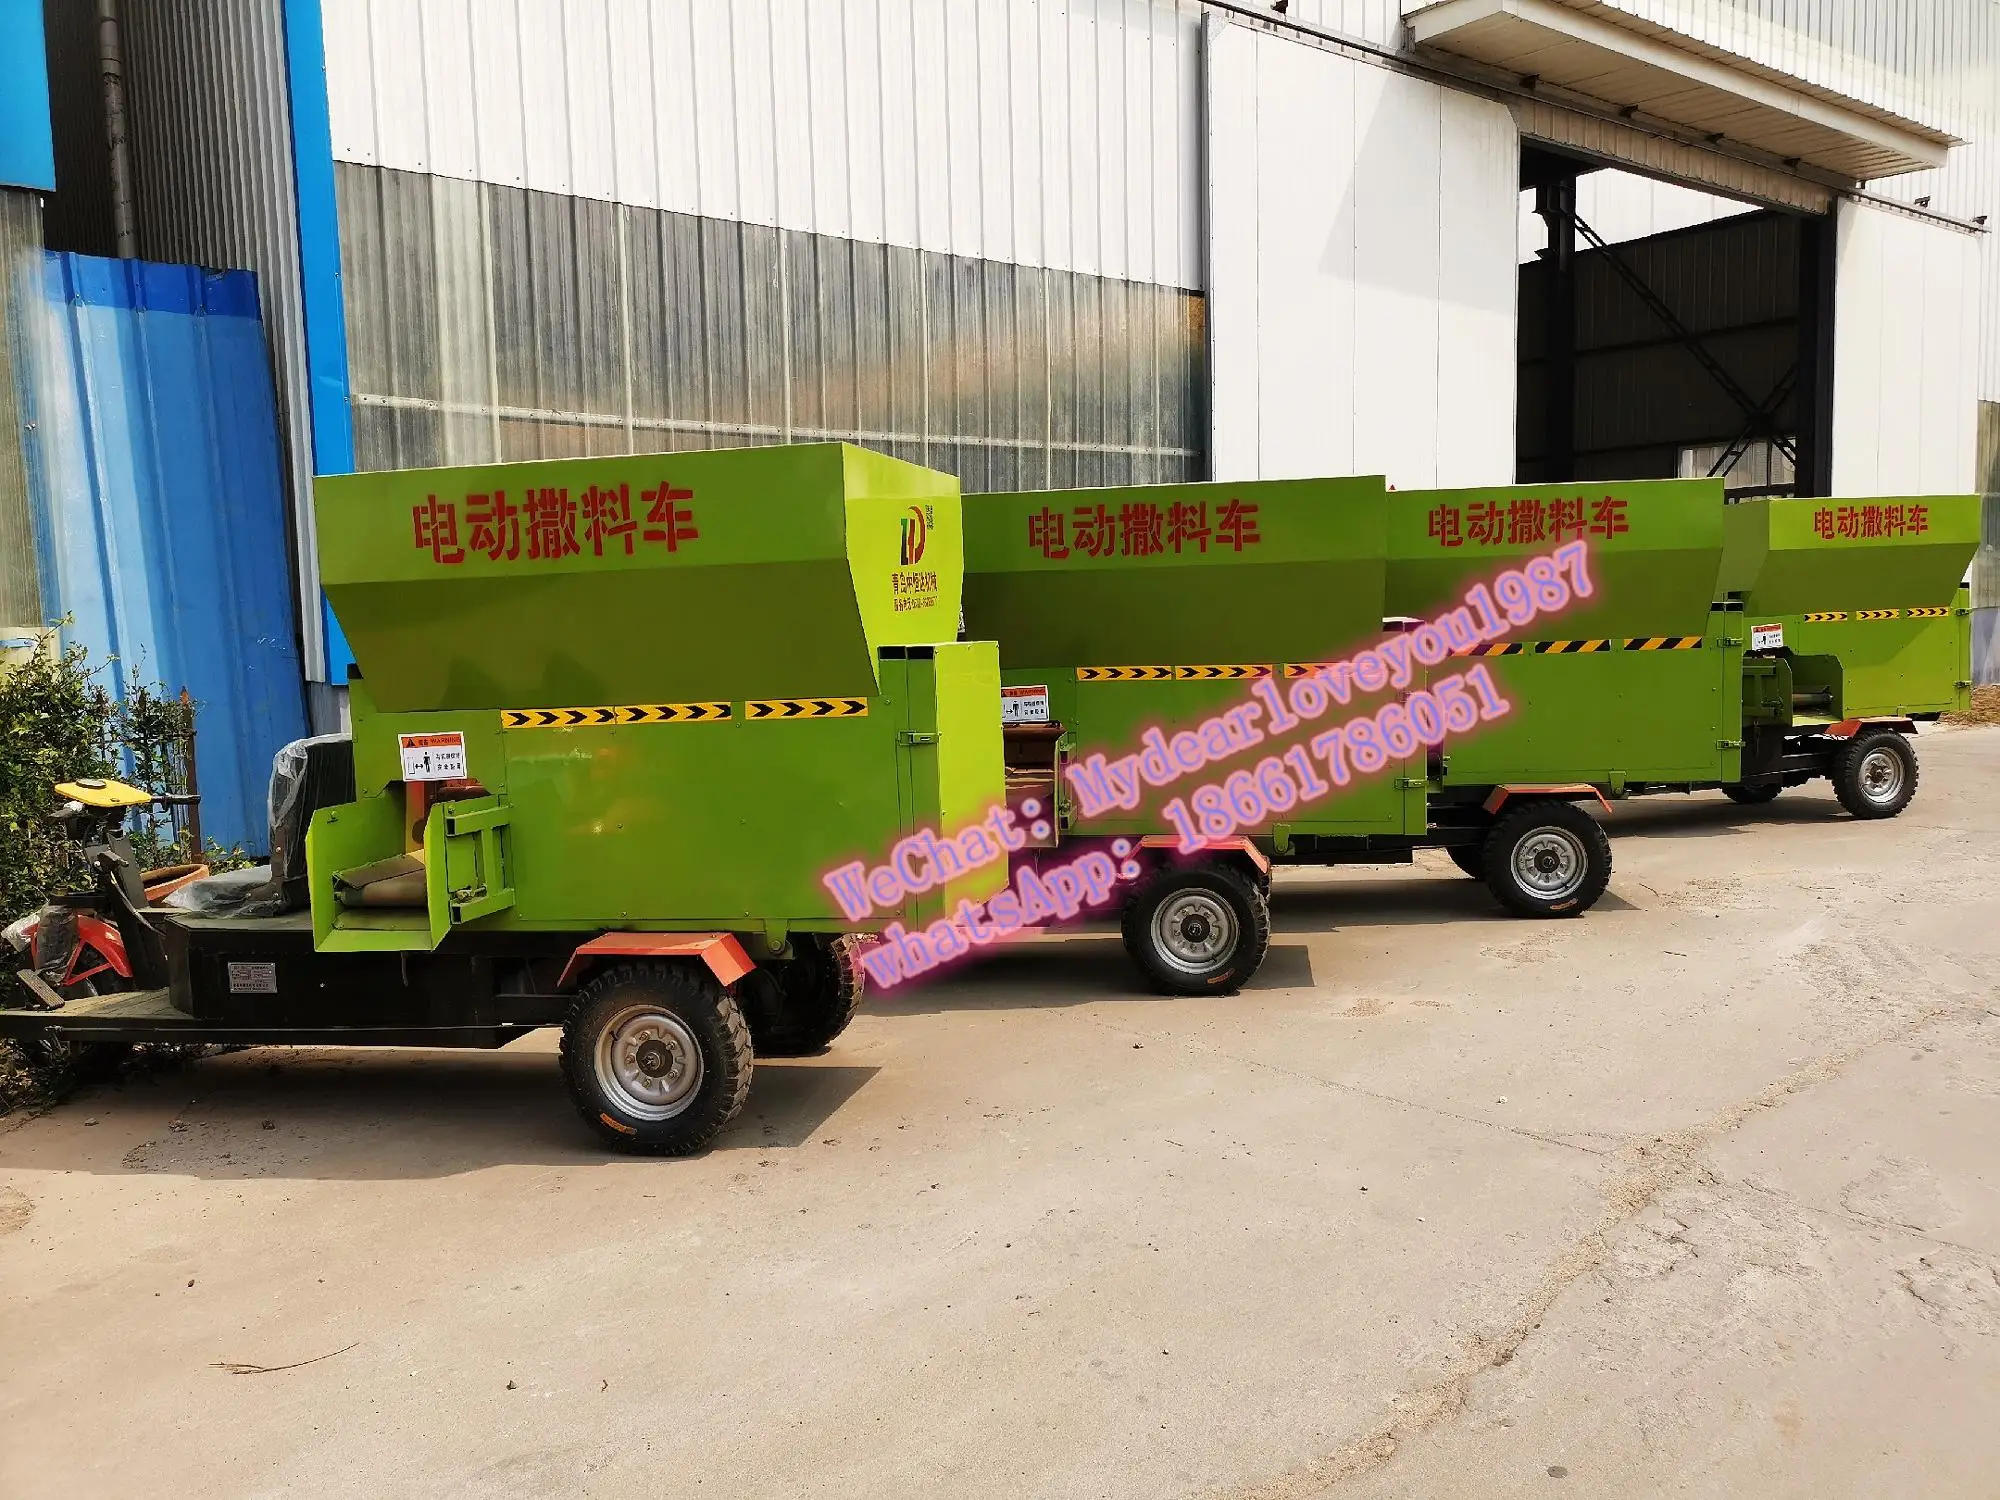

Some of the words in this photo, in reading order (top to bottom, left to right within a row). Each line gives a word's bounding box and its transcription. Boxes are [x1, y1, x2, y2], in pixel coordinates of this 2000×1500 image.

[412, 481, 699, 564] 电动撒料车
[1028, 499, 1260, 560] 电动撒料车
[1428, 495, 1629, 547] 电动撒料车
[1813, 504, 1929, 539] 电动撒料车
